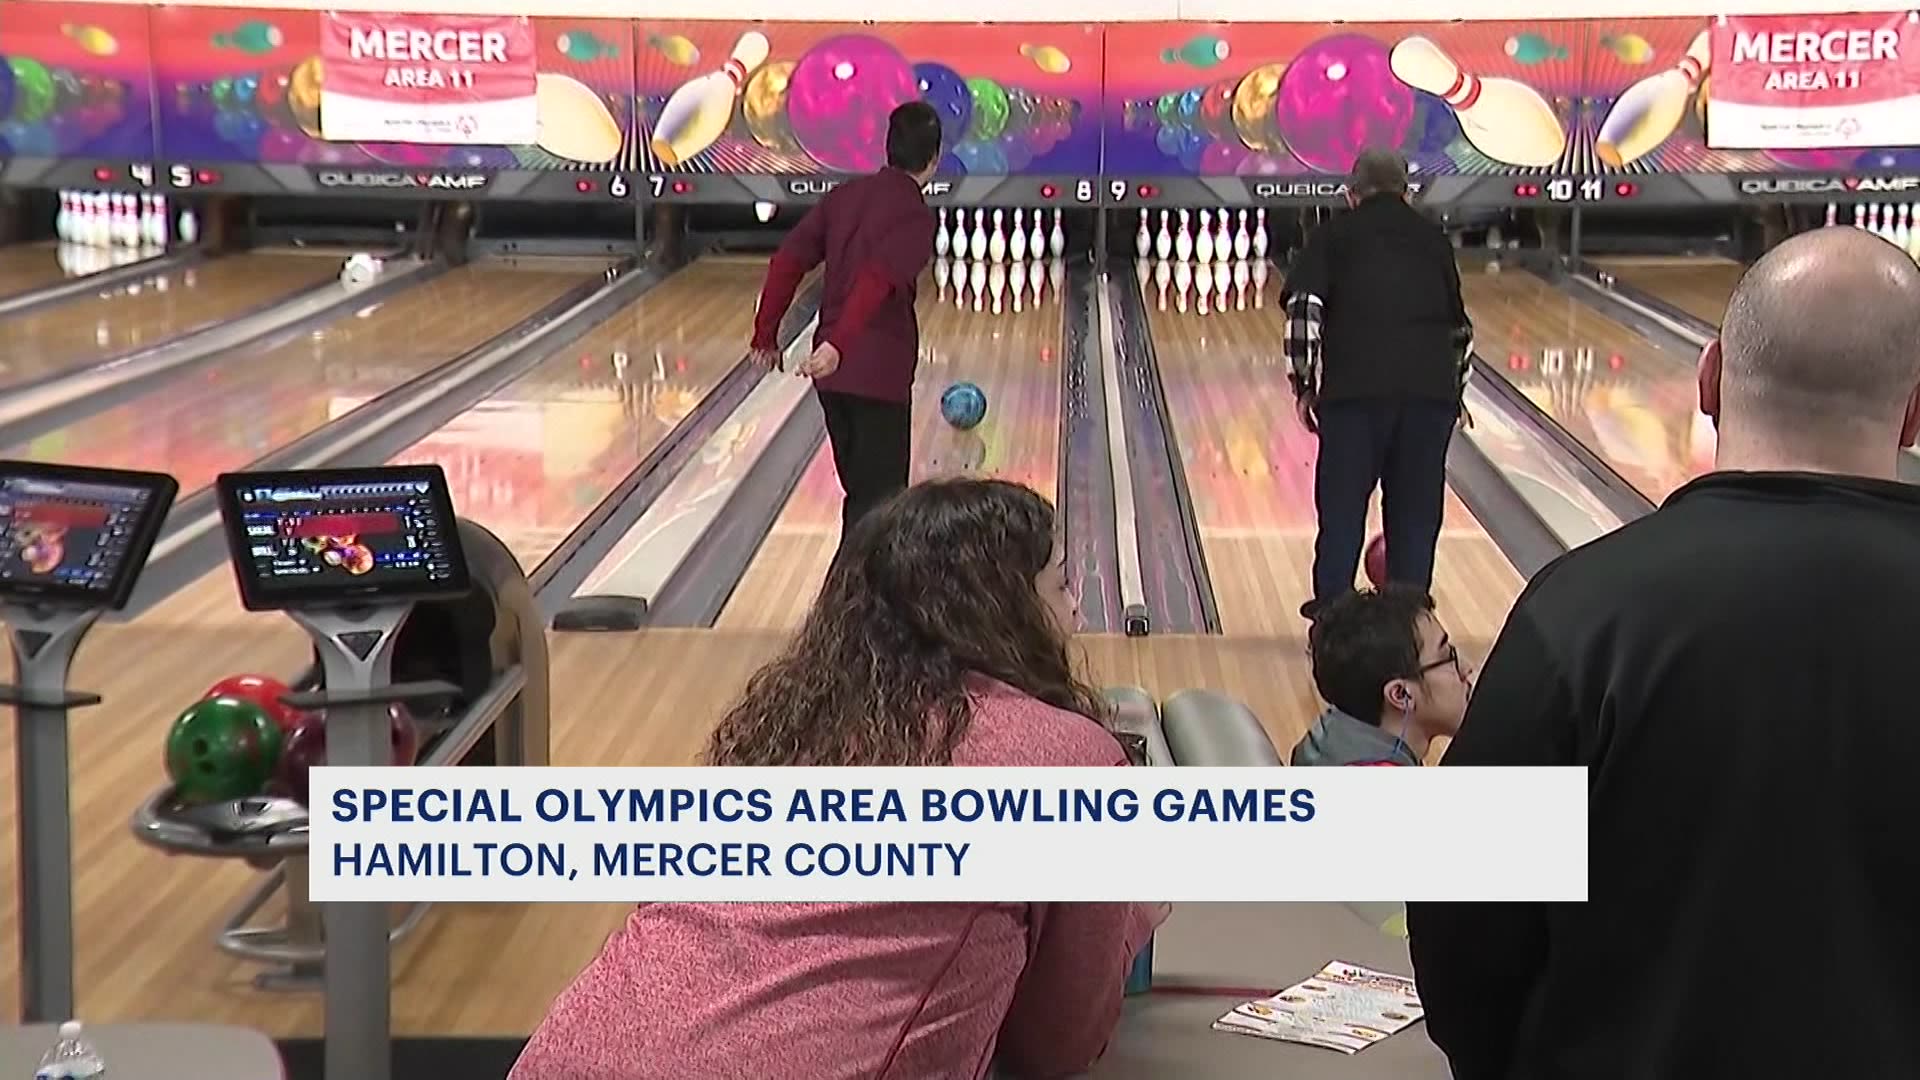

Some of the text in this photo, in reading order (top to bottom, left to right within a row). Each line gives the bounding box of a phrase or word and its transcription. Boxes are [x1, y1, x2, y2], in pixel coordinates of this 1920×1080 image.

[350, 26, 508, 62] MERCER
[1732, 27, 1900, 64] MERCER
[384, 67, 474, 89] AREA 11
[1764, 70, 1861, 91] AREA 11
[131, 162, 153, 187] 4
[170, 164, 192, 187] 5
[610, 174, 627, 197] 6
[648, 175, 665, 197] 7
[1076, 179, 1093, 201] 8
[1110, 180, 1127, 201] 9
[1546, 179, 1574, 201] 10
[1580, 179, 1602, 201] 11
